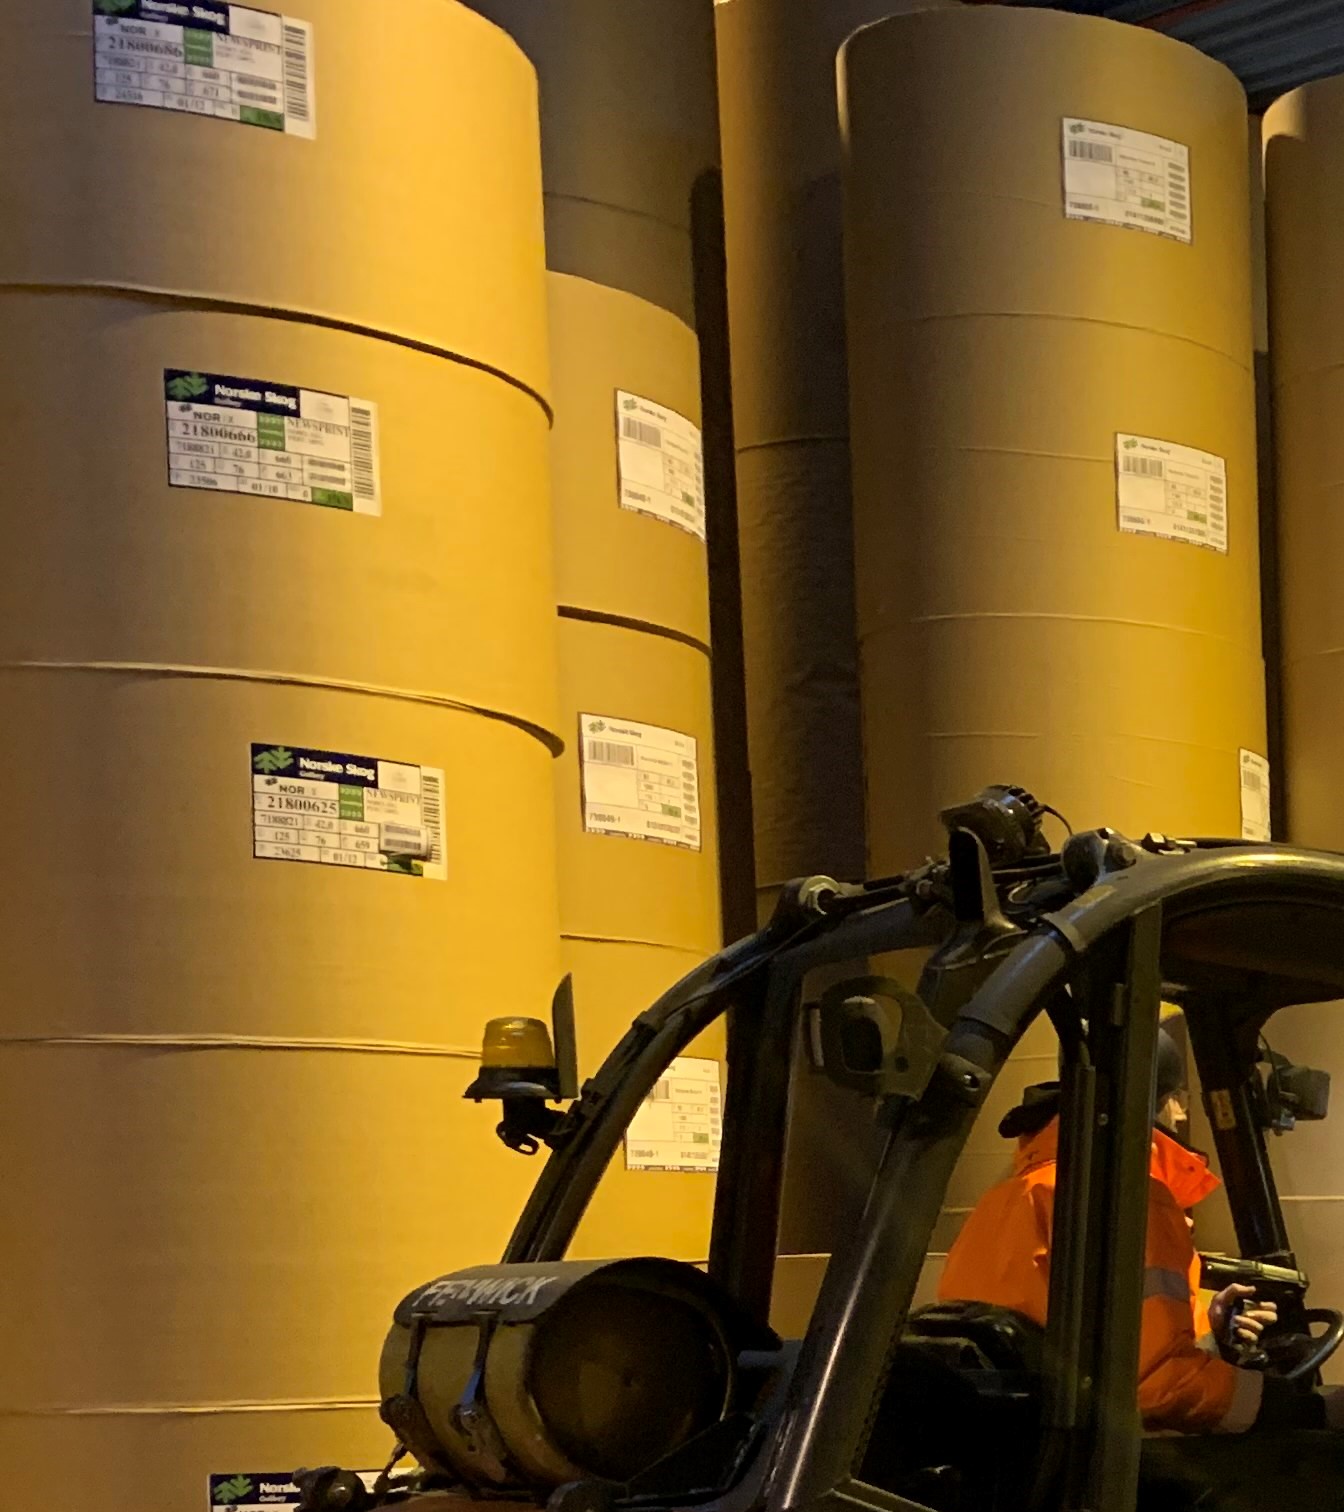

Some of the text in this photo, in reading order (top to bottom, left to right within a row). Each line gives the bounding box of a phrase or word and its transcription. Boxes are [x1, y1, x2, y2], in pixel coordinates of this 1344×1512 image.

[264, 390, 297, 410] Skog
[299, 757, 376, 782] Norske Skog
[278, 784, 305, 795] NOR
[267, 795, 338, 815] 21800625
[259, 1482, 301, 1493] Norsk
